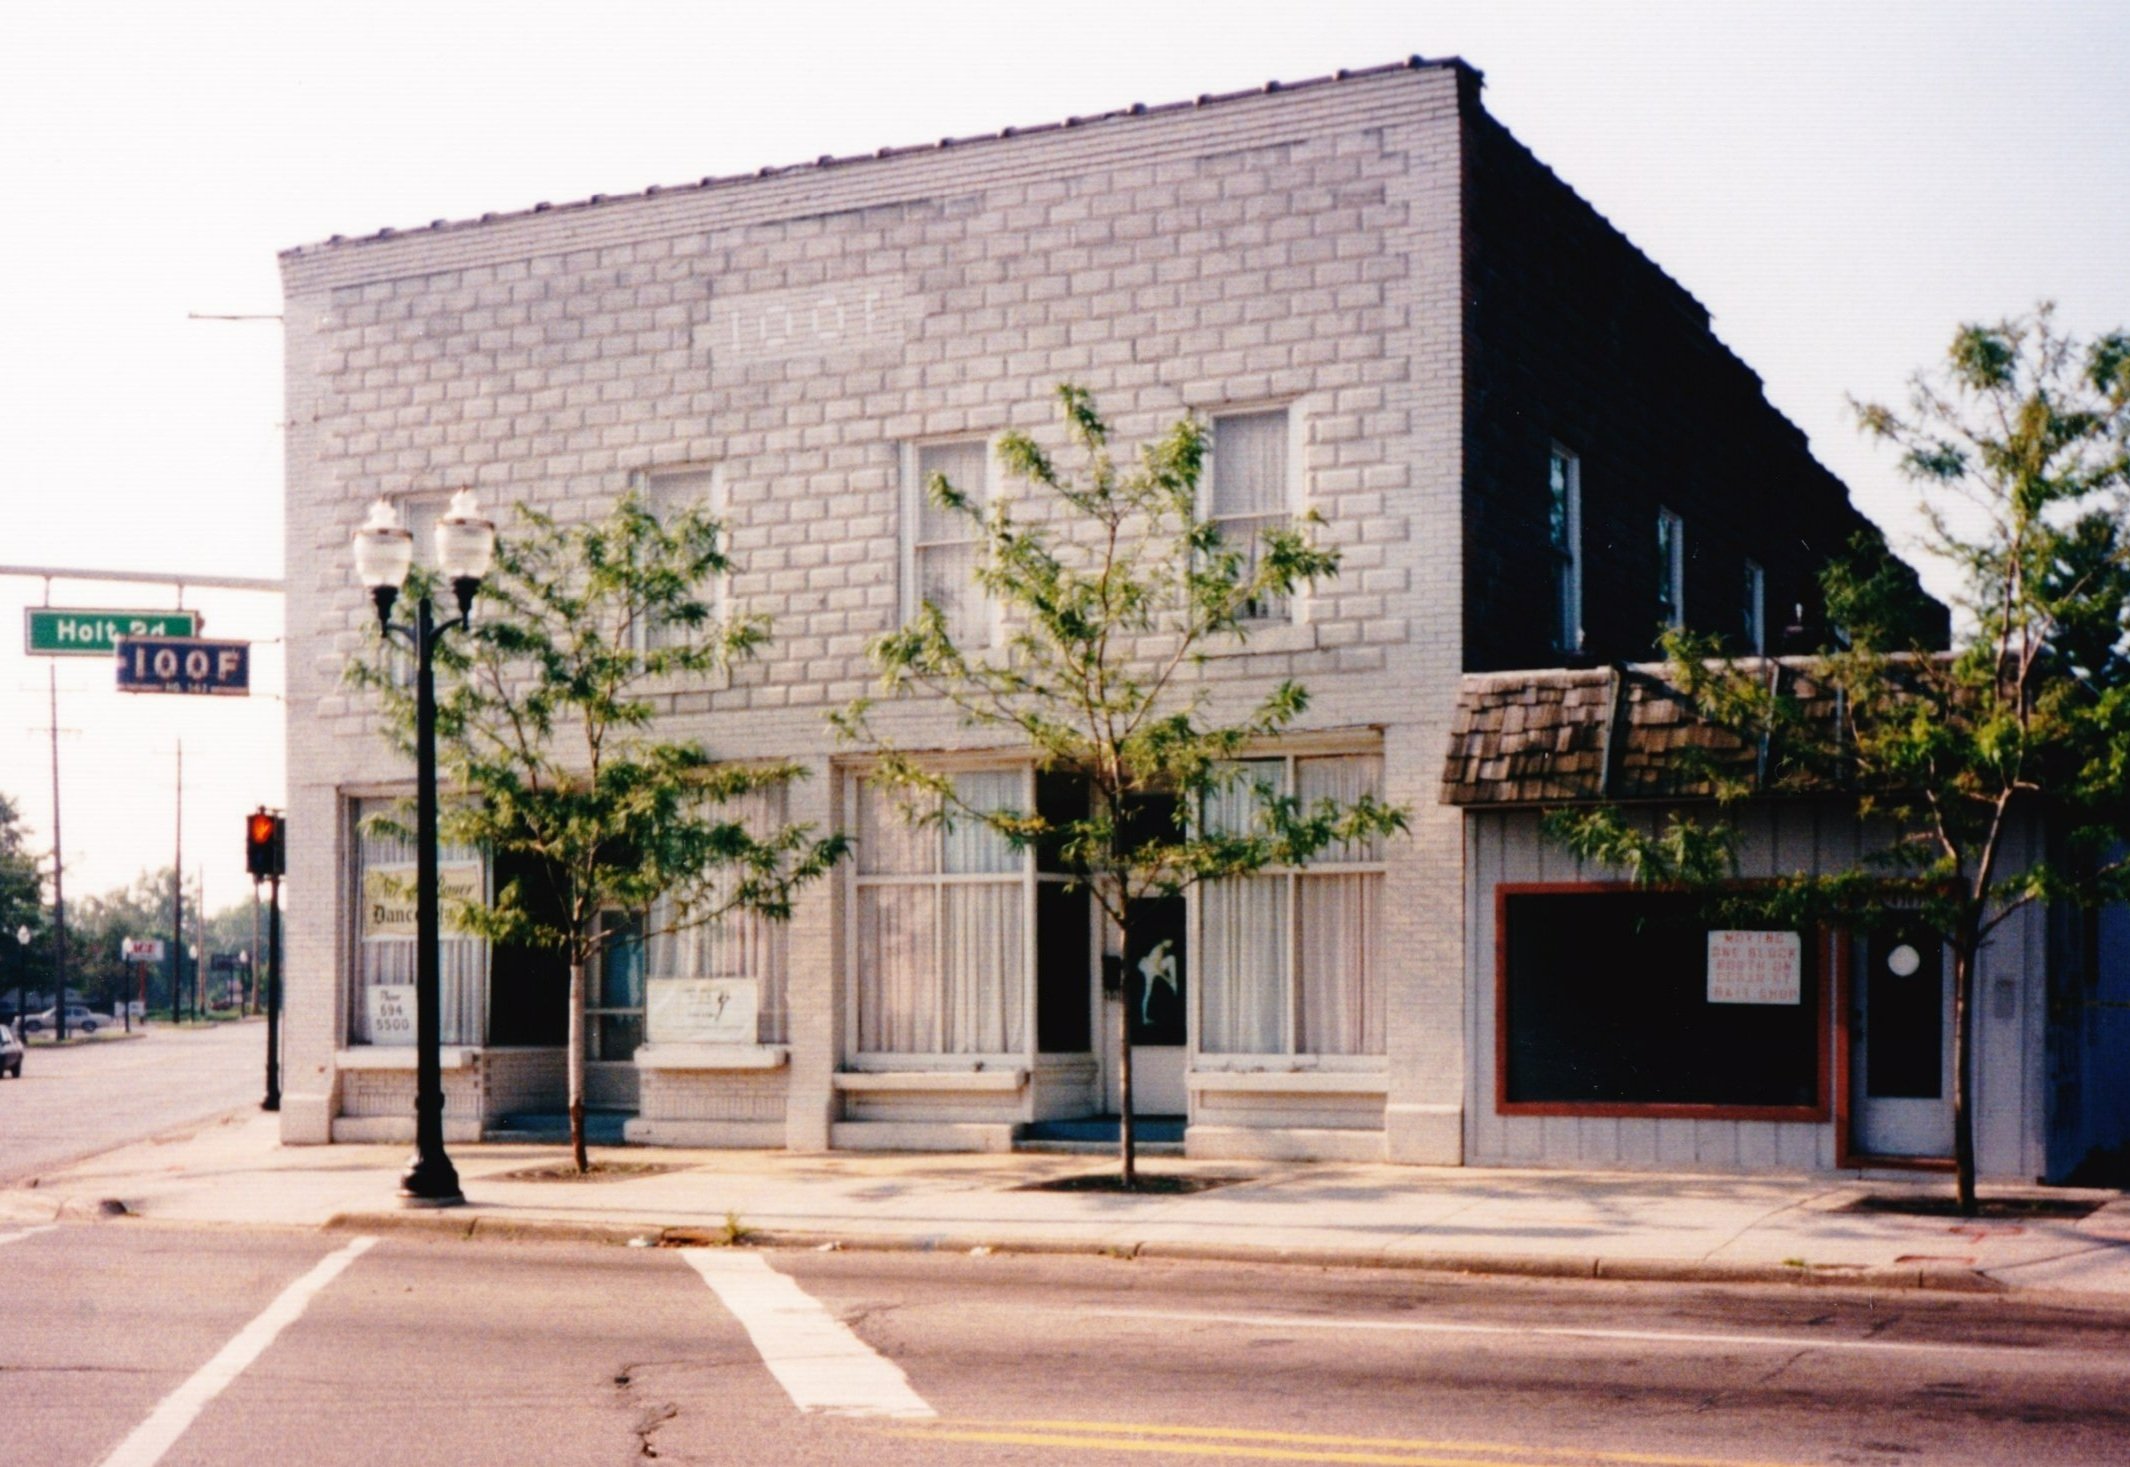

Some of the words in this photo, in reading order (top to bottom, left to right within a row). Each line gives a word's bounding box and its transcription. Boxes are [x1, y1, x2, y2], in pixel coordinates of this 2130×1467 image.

[57, 618, 118, 642] Holt
[1724, 933, 1784, 944] MOVING
[1711, 946, 1739, 958] ONE
[1748, 947, 1797, 960] BLOCK
